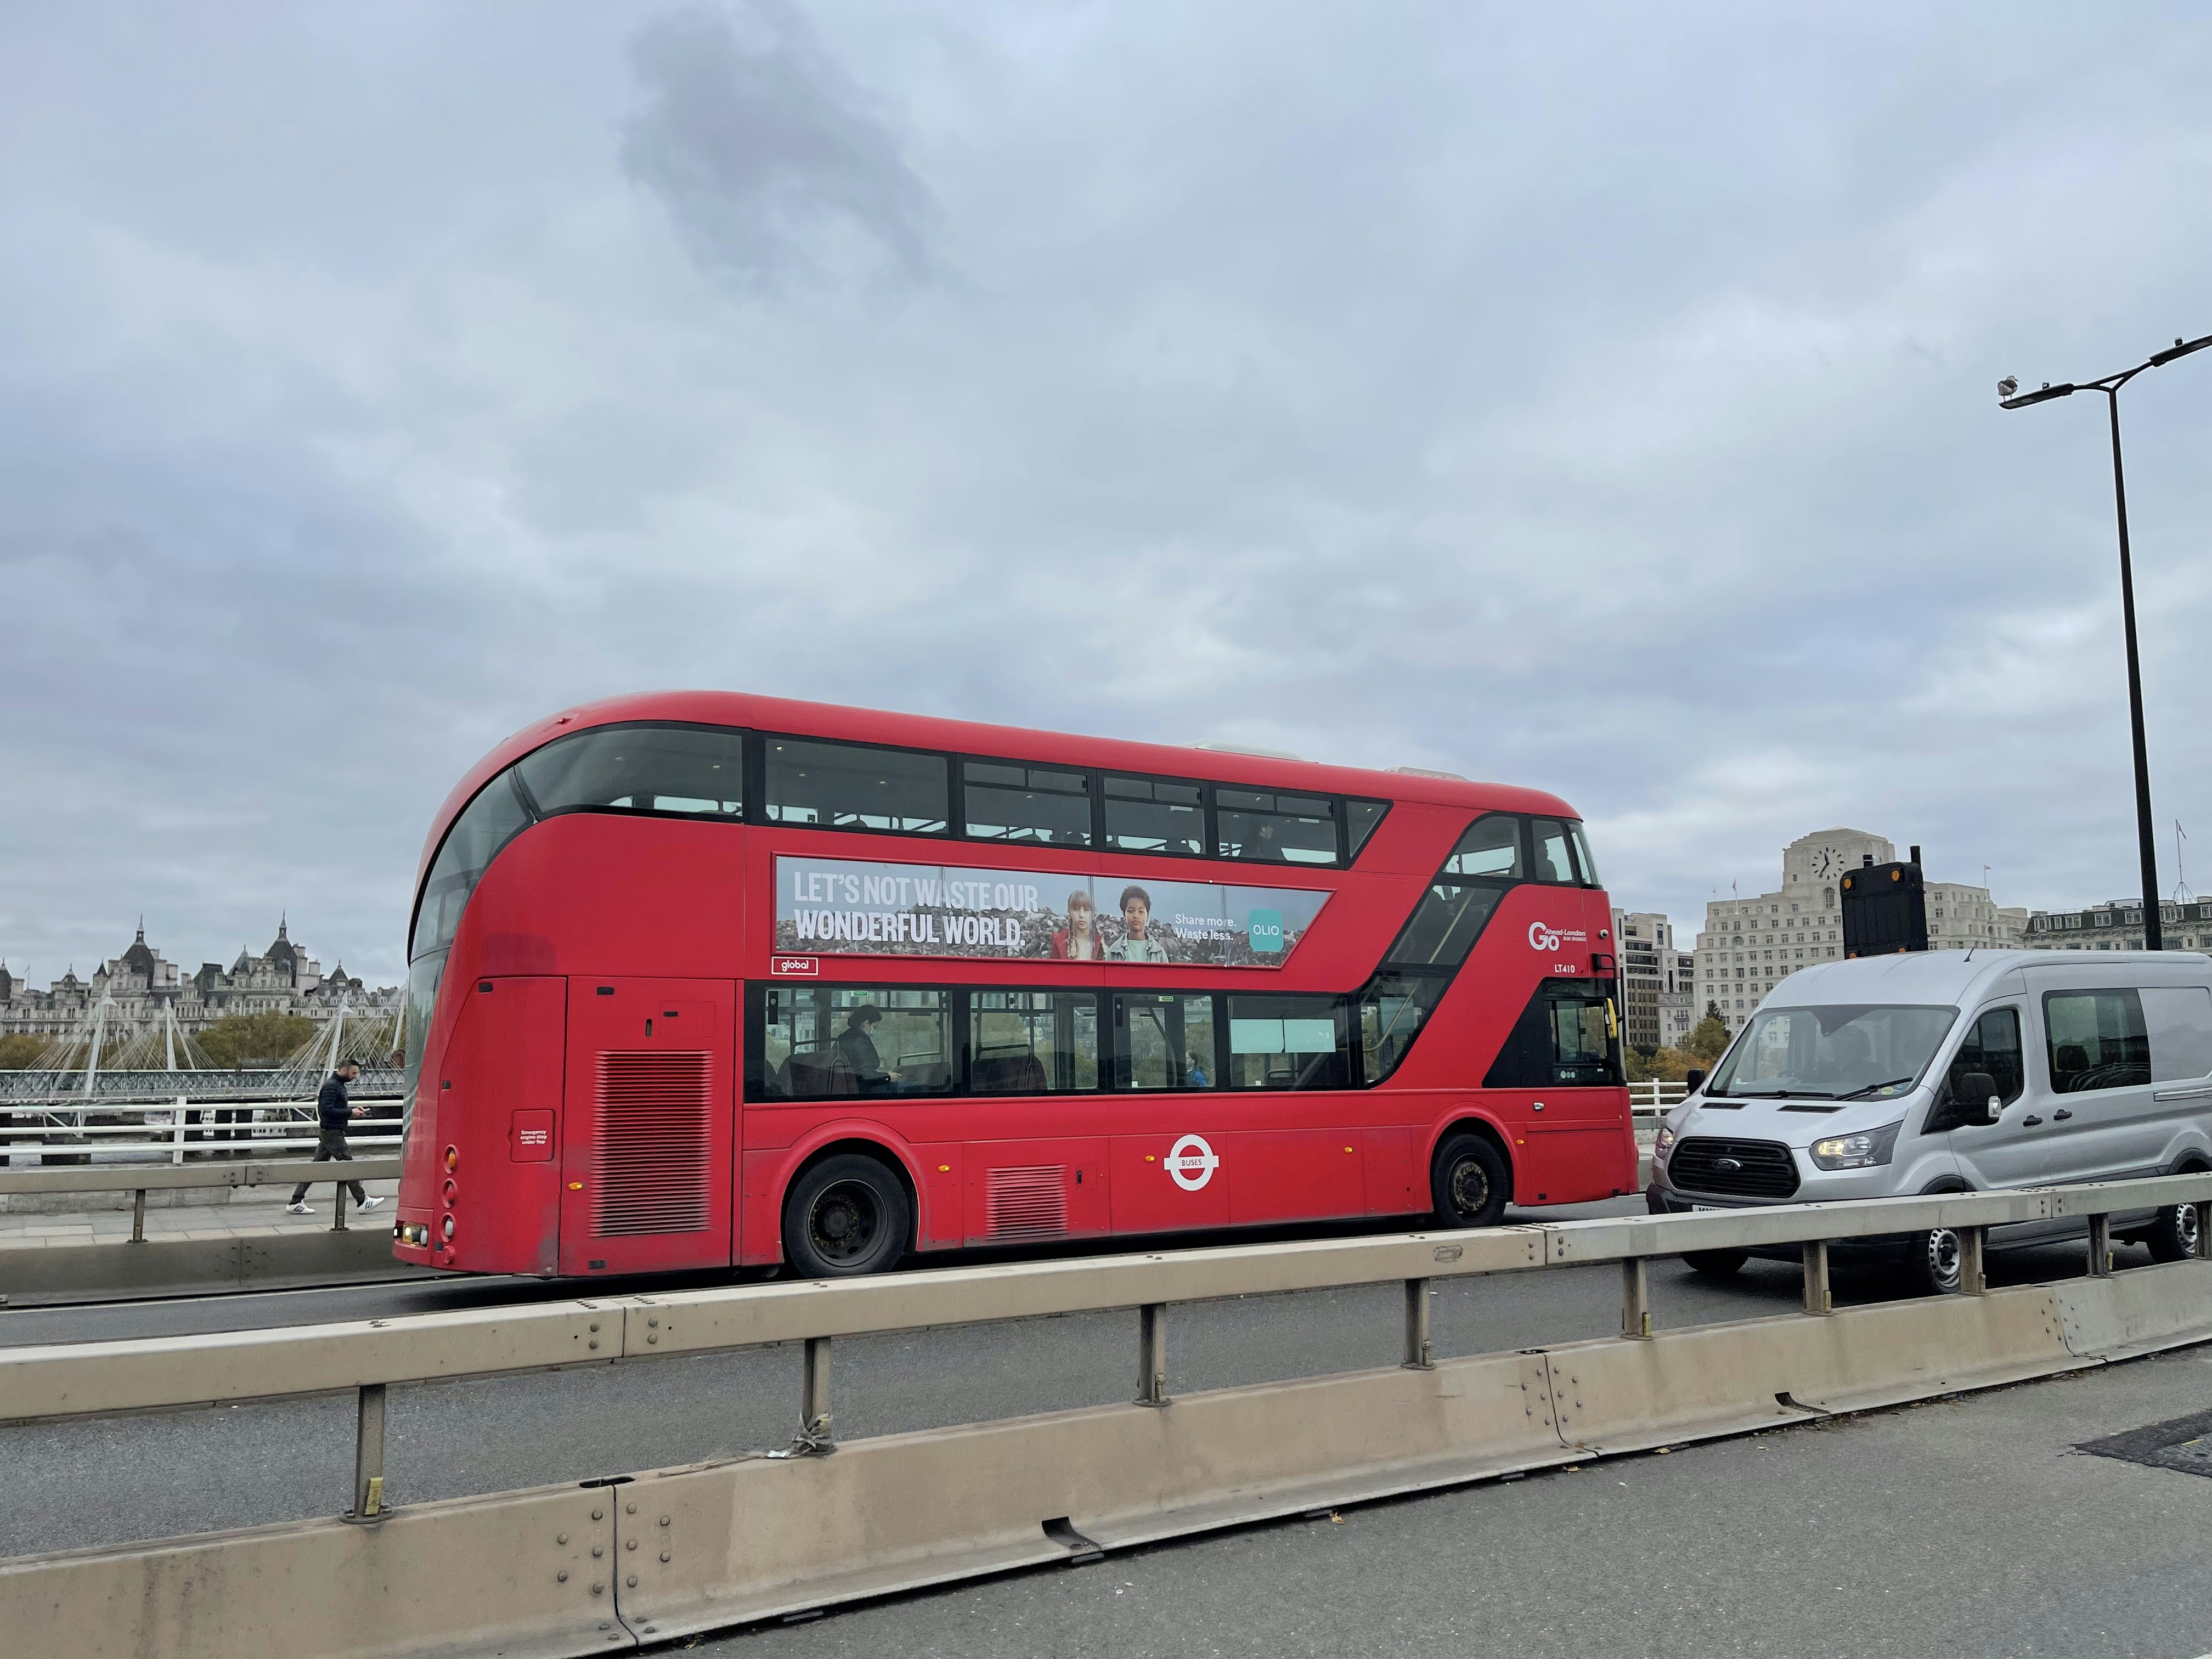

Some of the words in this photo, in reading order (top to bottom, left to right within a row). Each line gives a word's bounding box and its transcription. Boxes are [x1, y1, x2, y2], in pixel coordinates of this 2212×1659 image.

[794, 871, 860, 904] LET’S
[864, 876, 910, 906] NOT
[915, 878, 992, 910] WASTE
[994, 883, 1039, 912] OUR
[1175, 913, 1205, 926] Share
[1207, 917, 1237, 927] more.
[794, 909, 939, 944] WONDERFUL
[942, 915, 1026, 946] WORLD.
[1176, 927, 1208, 940] Waste
[1210, 928, 1233, 940] less.
[1252, 924, 1279, 936] OLIO
[1528, 921, 1560, 951] Go
[781, 960, 809, 972] global
[1554, 964, 1575, 973] LT410
